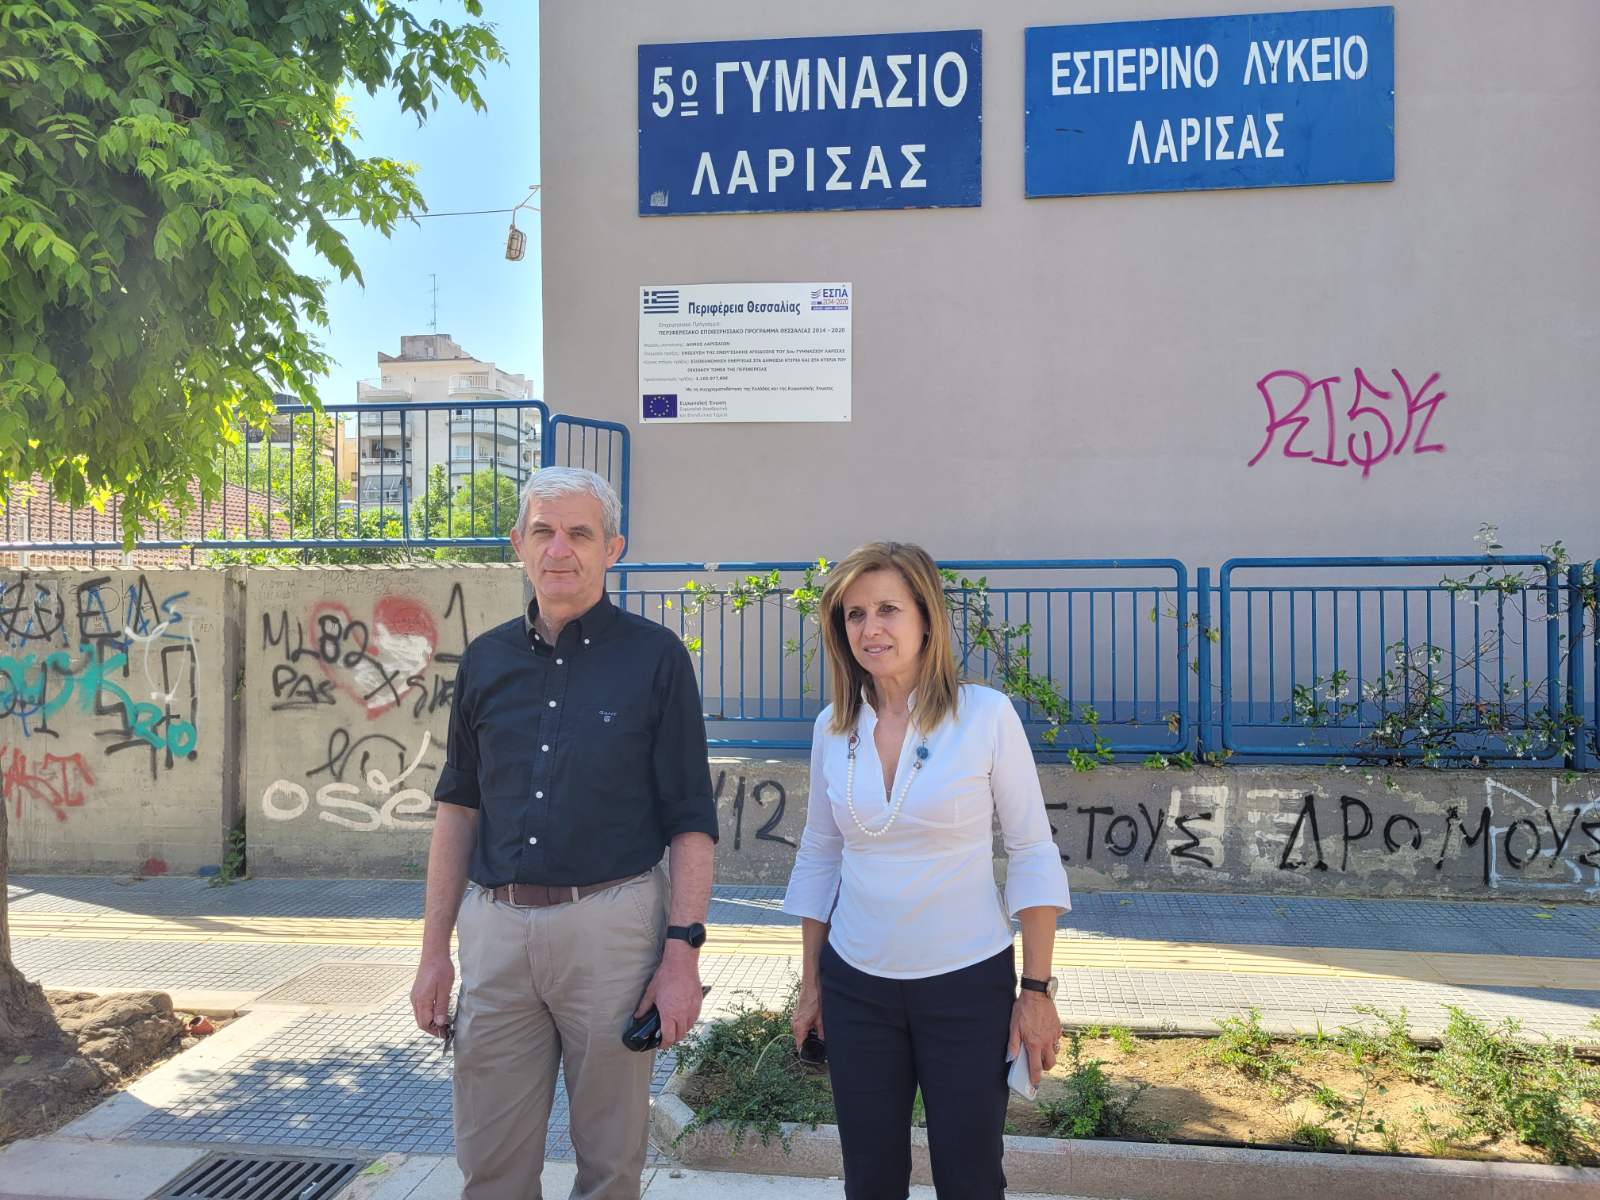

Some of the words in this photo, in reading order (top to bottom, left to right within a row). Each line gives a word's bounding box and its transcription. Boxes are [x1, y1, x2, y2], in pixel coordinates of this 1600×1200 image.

[715, 51, 968, 115] ΓΥΜΝΑΣΙΟ
[1051, 43, 1219, 96] ΕΣΠΕΡΙΝΟ
[1243, 35, 1368, 86] ΛΥΚΕΙΟ
[1127, 112, 1285, 165] ΛΑΡΙΣΑΣ
[691, 144, 927, 196] ΛΑΡΙΣΑΣ
[688, 301, 744, 317] Περιφέρεια
[746, 300, 801, 316] Θεσσαλίας
[822, 288, 849, 298] ΕΣΠΑ
